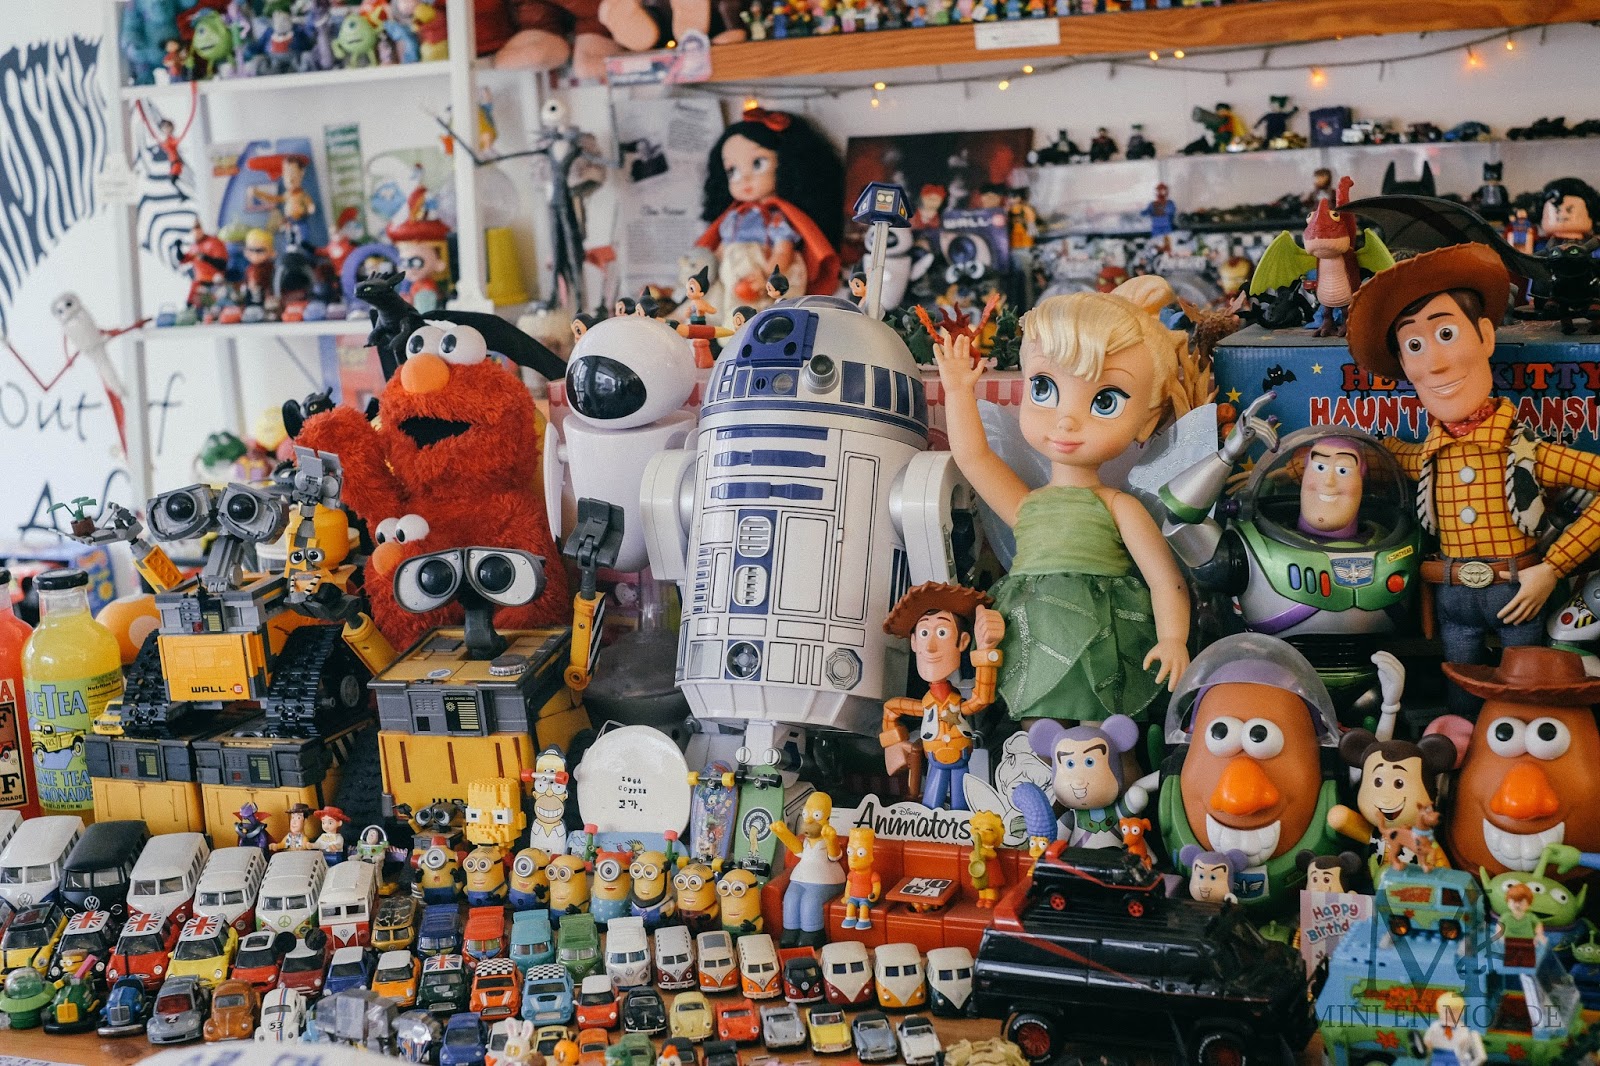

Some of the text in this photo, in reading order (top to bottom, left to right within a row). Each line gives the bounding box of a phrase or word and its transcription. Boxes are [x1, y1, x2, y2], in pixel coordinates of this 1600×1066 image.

[1309, 396, 1436, 439] HAUNT
[853, 802, 971, 840] Animators
[1312, 903, 1360, 920] Happy
[1306, 919, 1350, 942] Birthd
[269, 1021, 284, 1031] 53
